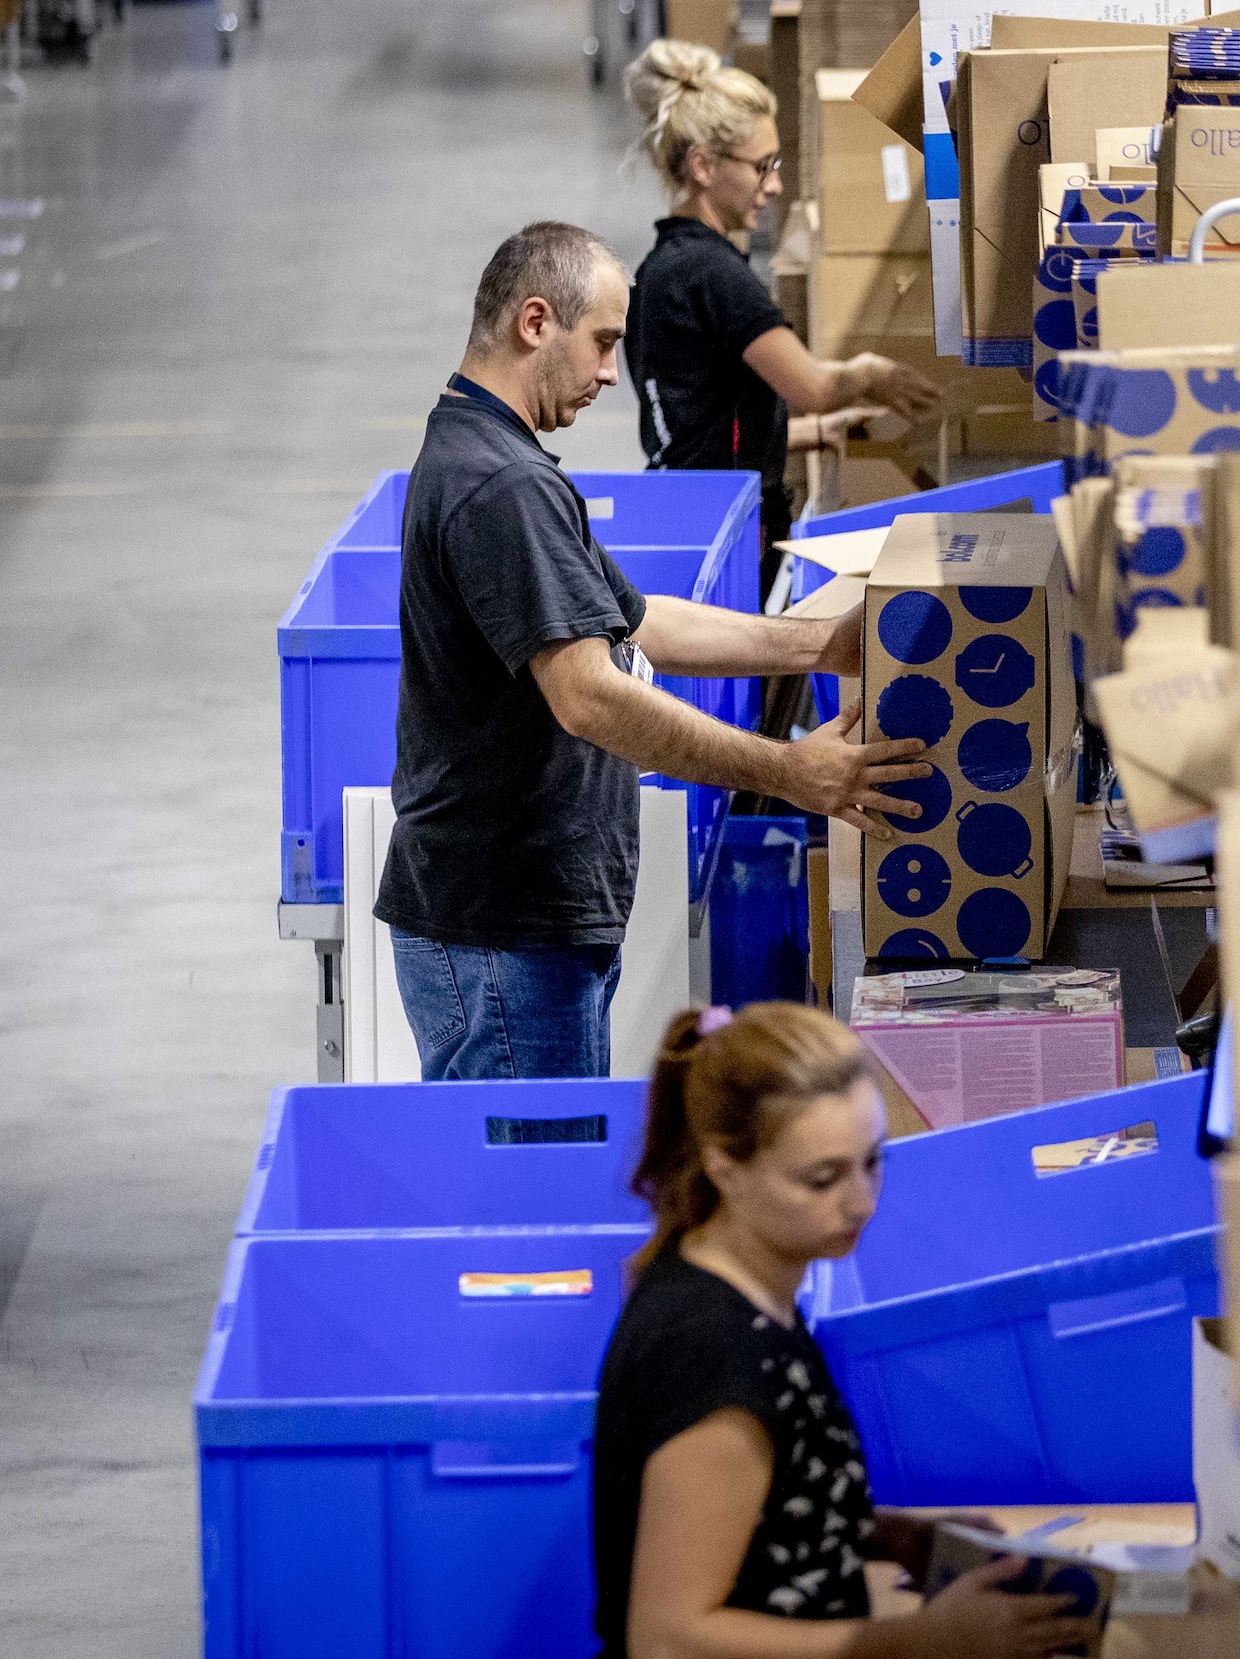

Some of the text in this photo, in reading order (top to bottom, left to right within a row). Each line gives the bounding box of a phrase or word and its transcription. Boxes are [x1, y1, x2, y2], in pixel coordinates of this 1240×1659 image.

[950, 24, 959, 32] je
[950, 34, 958, 49] met
[935, 534, 980, 562] bol.com
